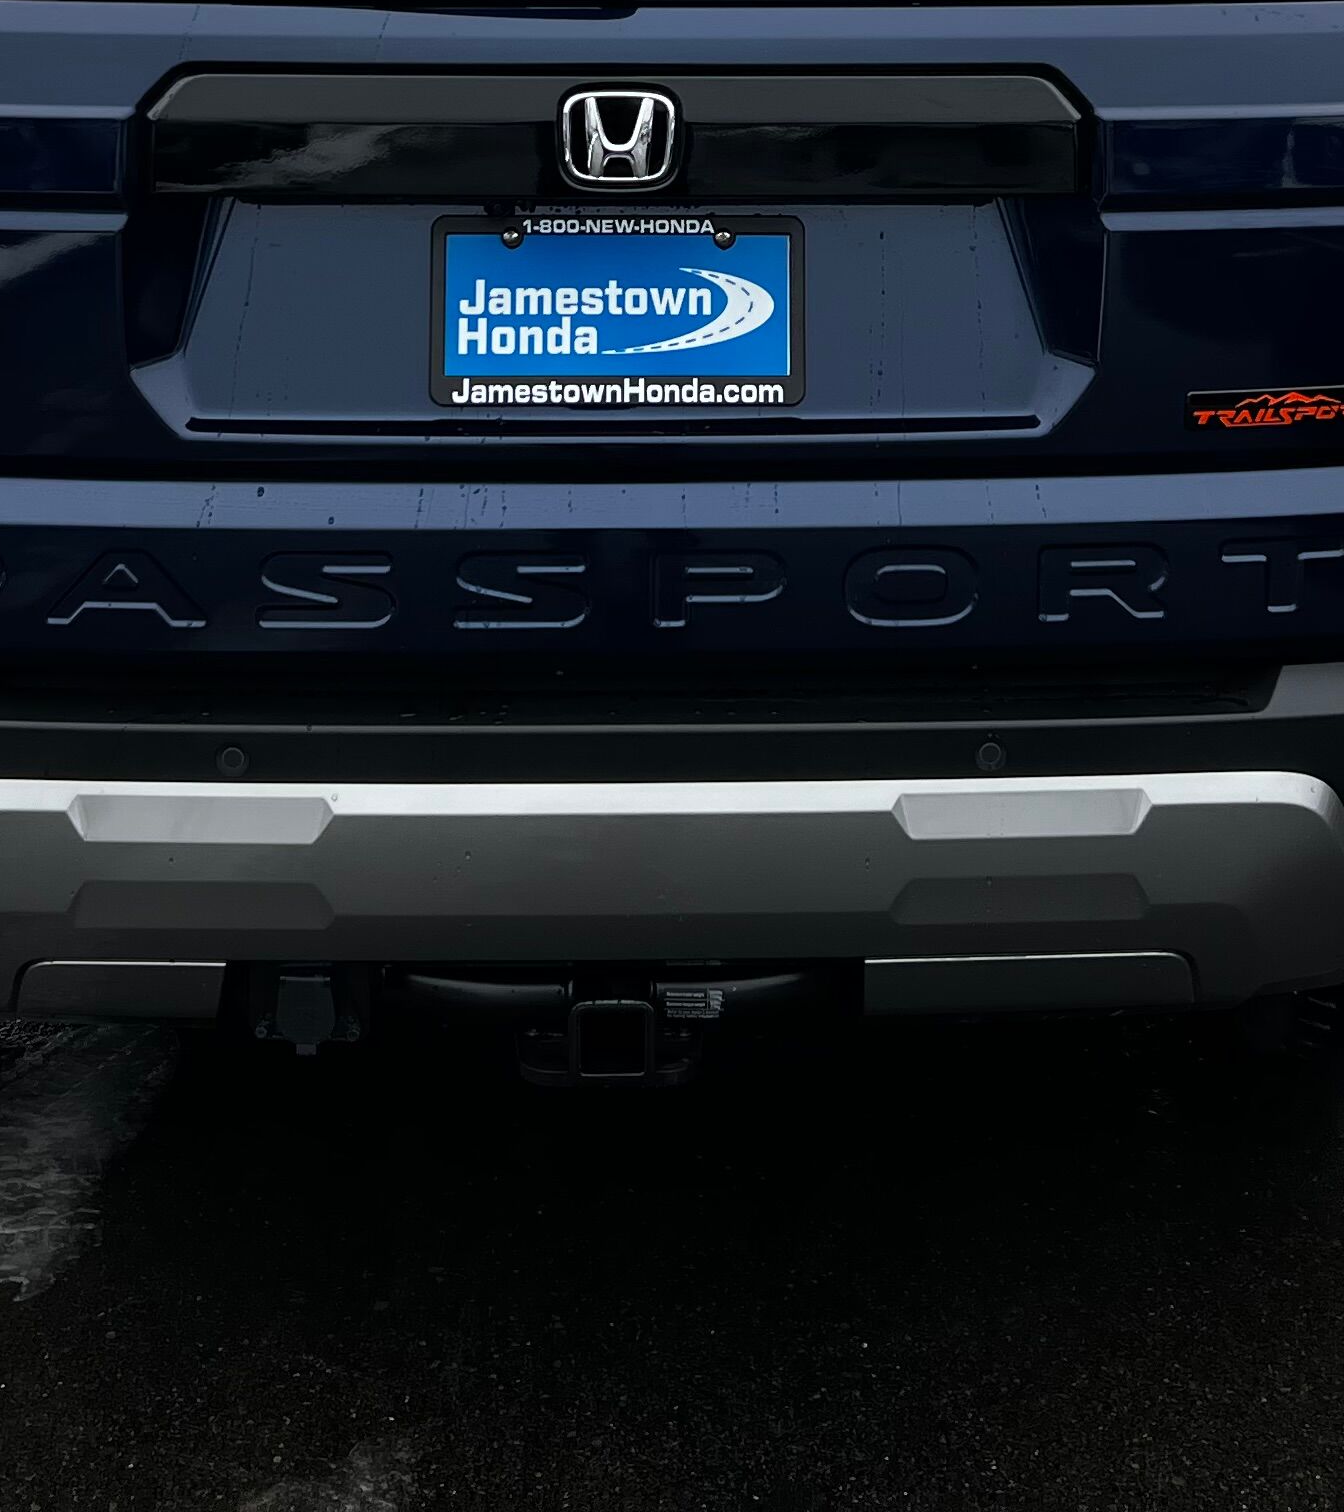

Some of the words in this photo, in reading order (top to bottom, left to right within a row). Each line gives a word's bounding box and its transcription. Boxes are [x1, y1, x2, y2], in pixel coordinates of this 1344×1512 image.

[522, 218, 715, 235] 1-800-NEW-HONDA
[459, 278, 713, 315] Jamestown
[457, 316, 598, 355] Honda
[451, 377, 784, 404] JamestownHonda.com
